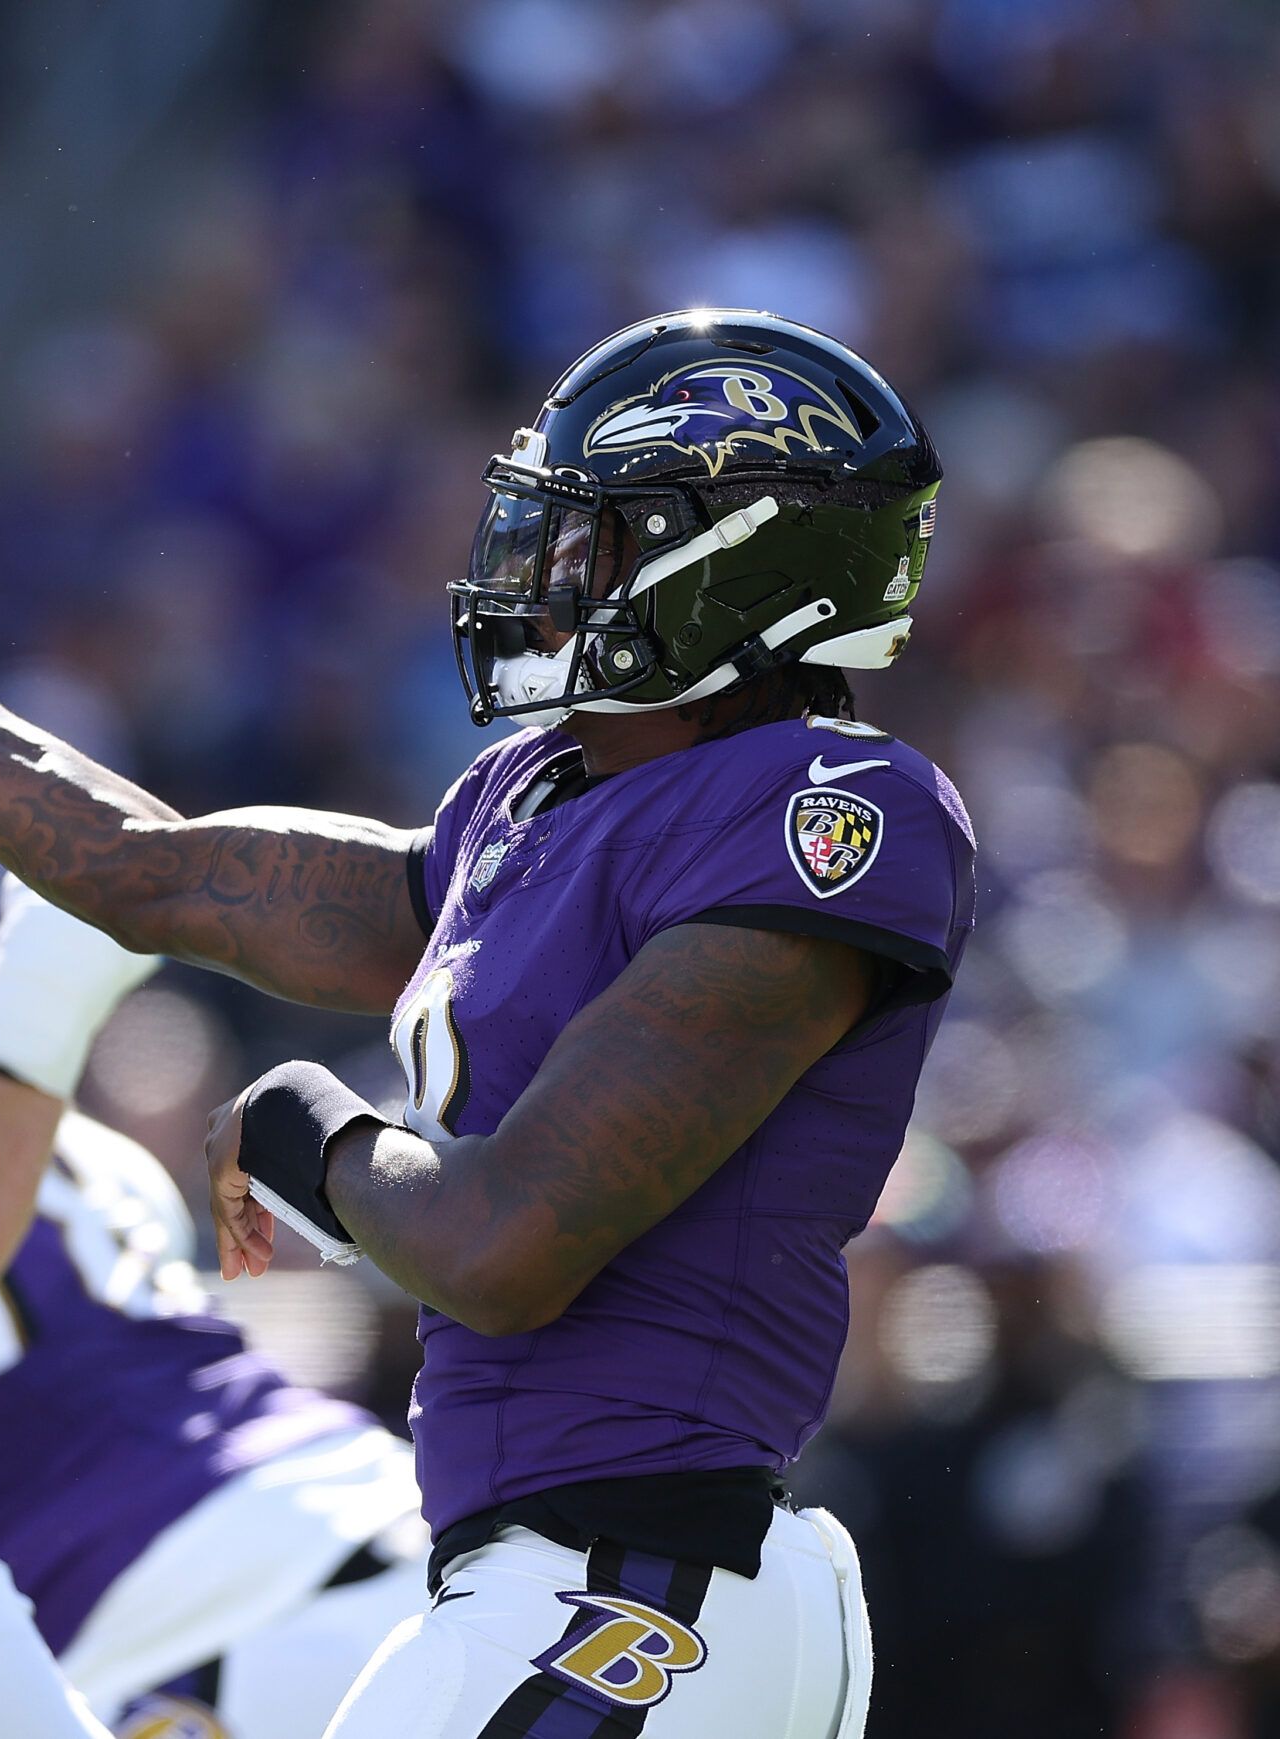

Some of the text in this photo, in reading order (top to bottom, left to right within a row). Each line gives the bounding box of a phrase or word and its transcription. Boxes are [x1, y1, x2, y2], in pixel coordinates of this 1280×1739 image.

[684, 367, 789, 422] B
[797, 809, 840, 836] B
[800, 796, 872, 822] RAVENS
[827, 843, 860, 875] R
[530, 1590, 709, 1708] B
